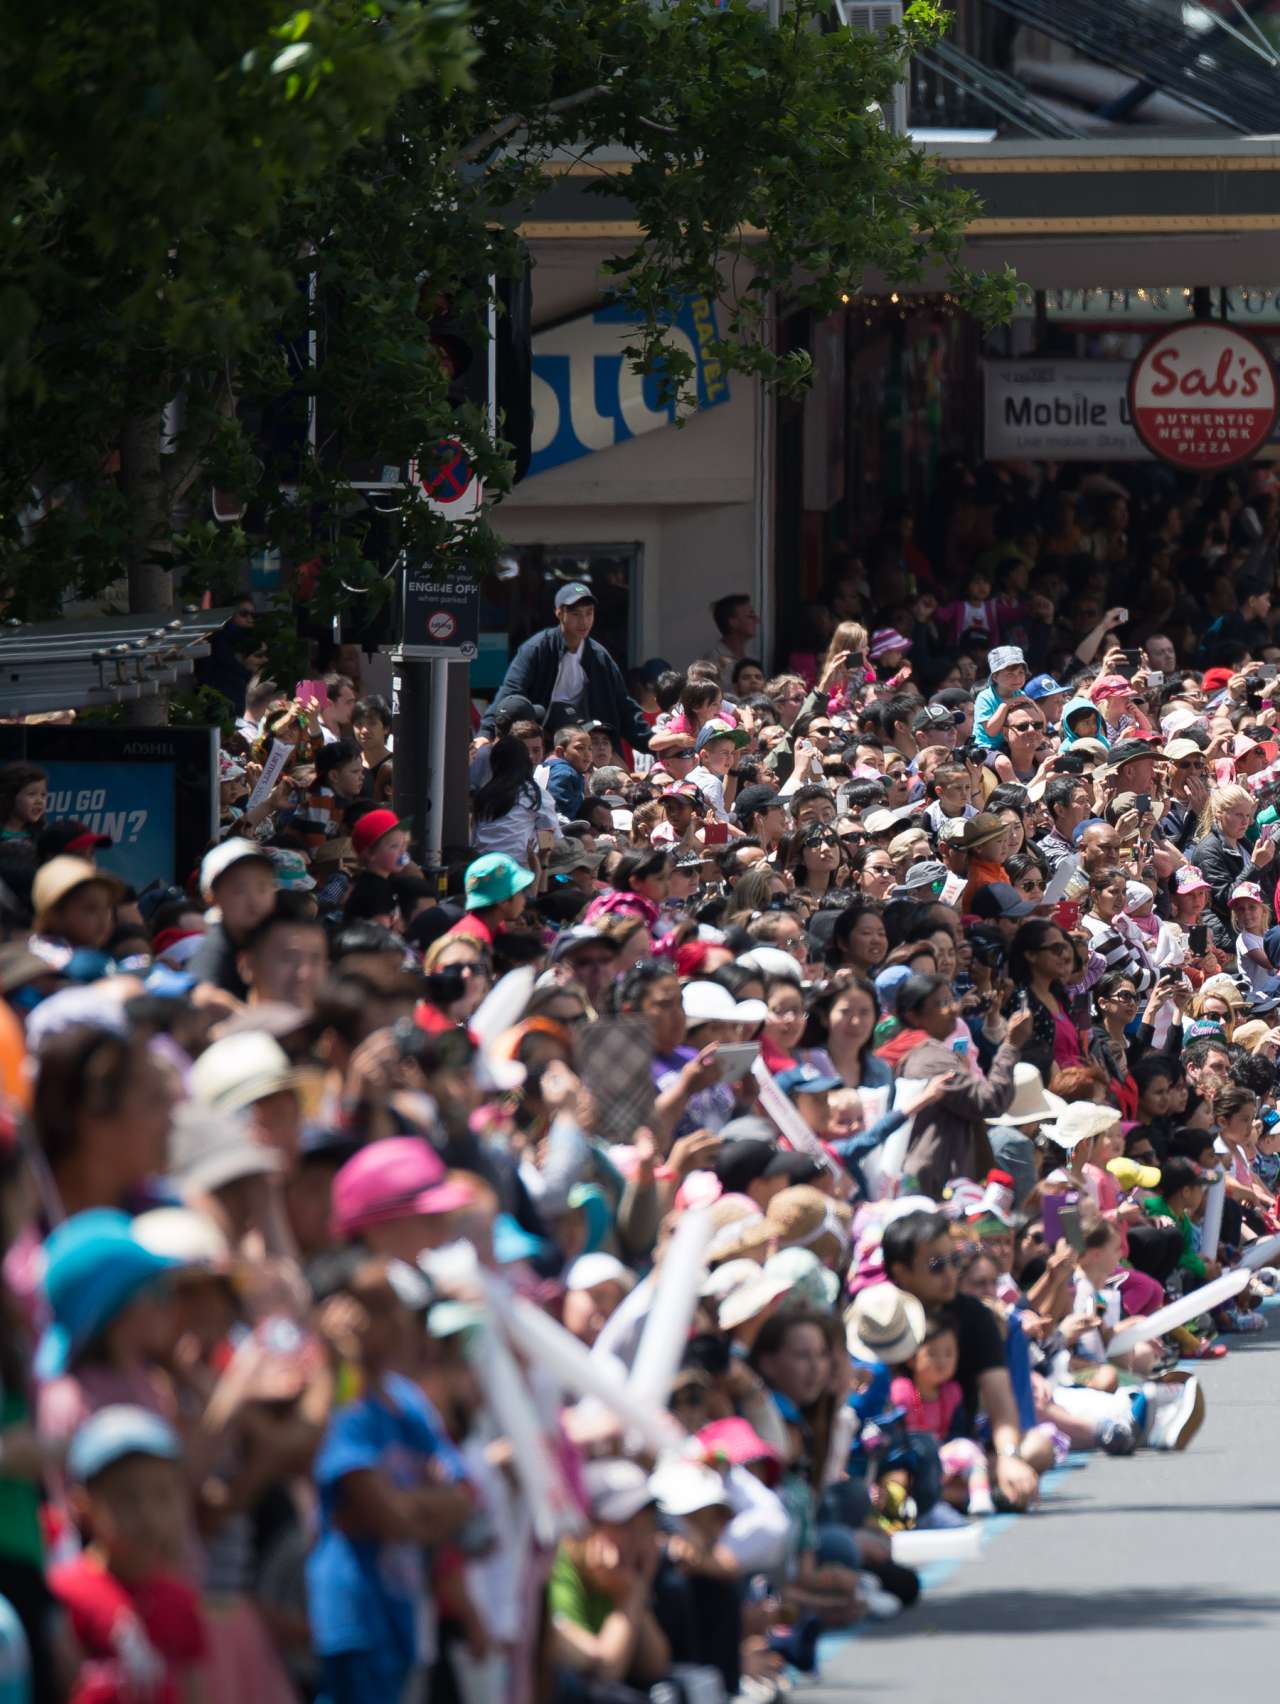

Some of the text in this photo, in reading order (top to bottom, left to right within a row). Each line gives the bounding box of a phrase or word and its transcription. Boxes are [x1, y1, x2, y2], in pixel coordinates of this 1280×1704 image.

[1150, 347, 1262, 396] Sal's
[1005, 396, 1107, 427] Mobile
[1155, 413, 1255, 426] AUTHENTIC
[1157, 427, 1251, 440] NEW YORK
[1177, 441, 1232, 454] PIZZA
[408, 581, 453, 593] ENGINE
[46, 788, 107, 813] OU GO
